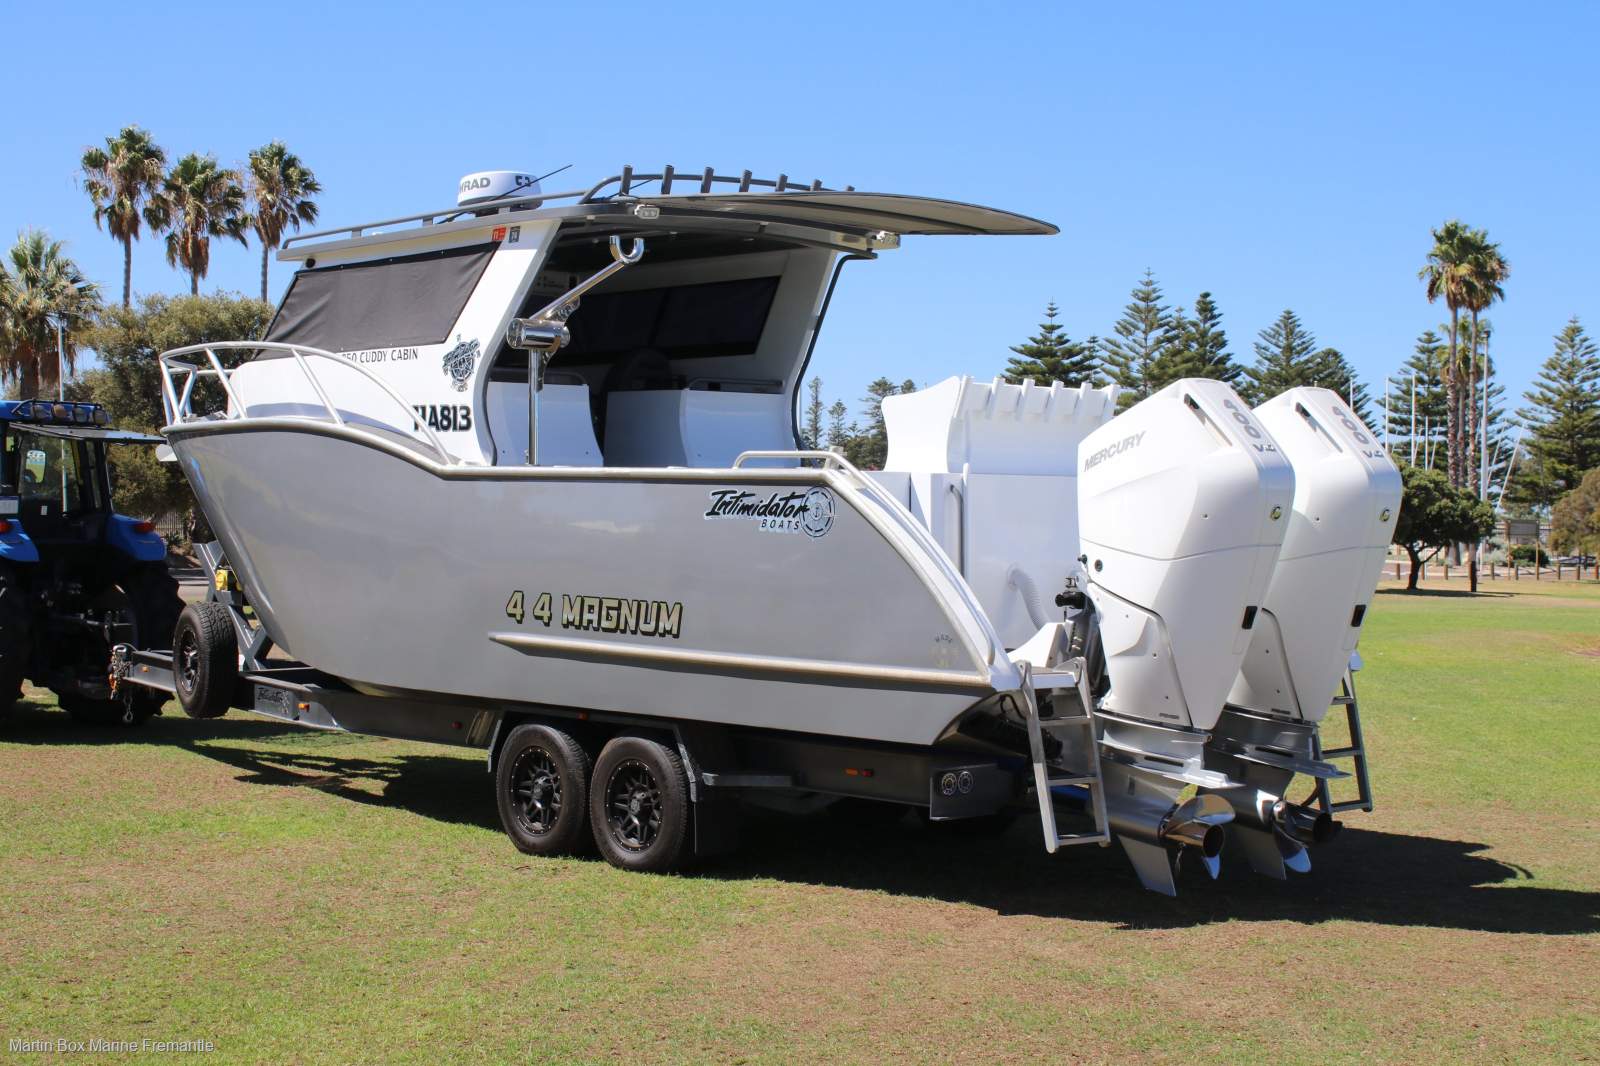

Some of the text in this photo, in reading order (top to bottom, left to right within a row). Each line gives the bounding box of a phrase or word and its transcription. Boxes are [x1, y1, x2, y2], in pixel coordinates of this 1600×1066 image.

[360, 350, 387, 363] CUDDY
[391, 348, 418, 360] CABIN
[1083, 430, 1146, 472] MERCURY
[705, 490, 810, 518] Intimidator
[761, 519, 800, 530] BOATS
[561, 594, 683, 638] MAGNUM
